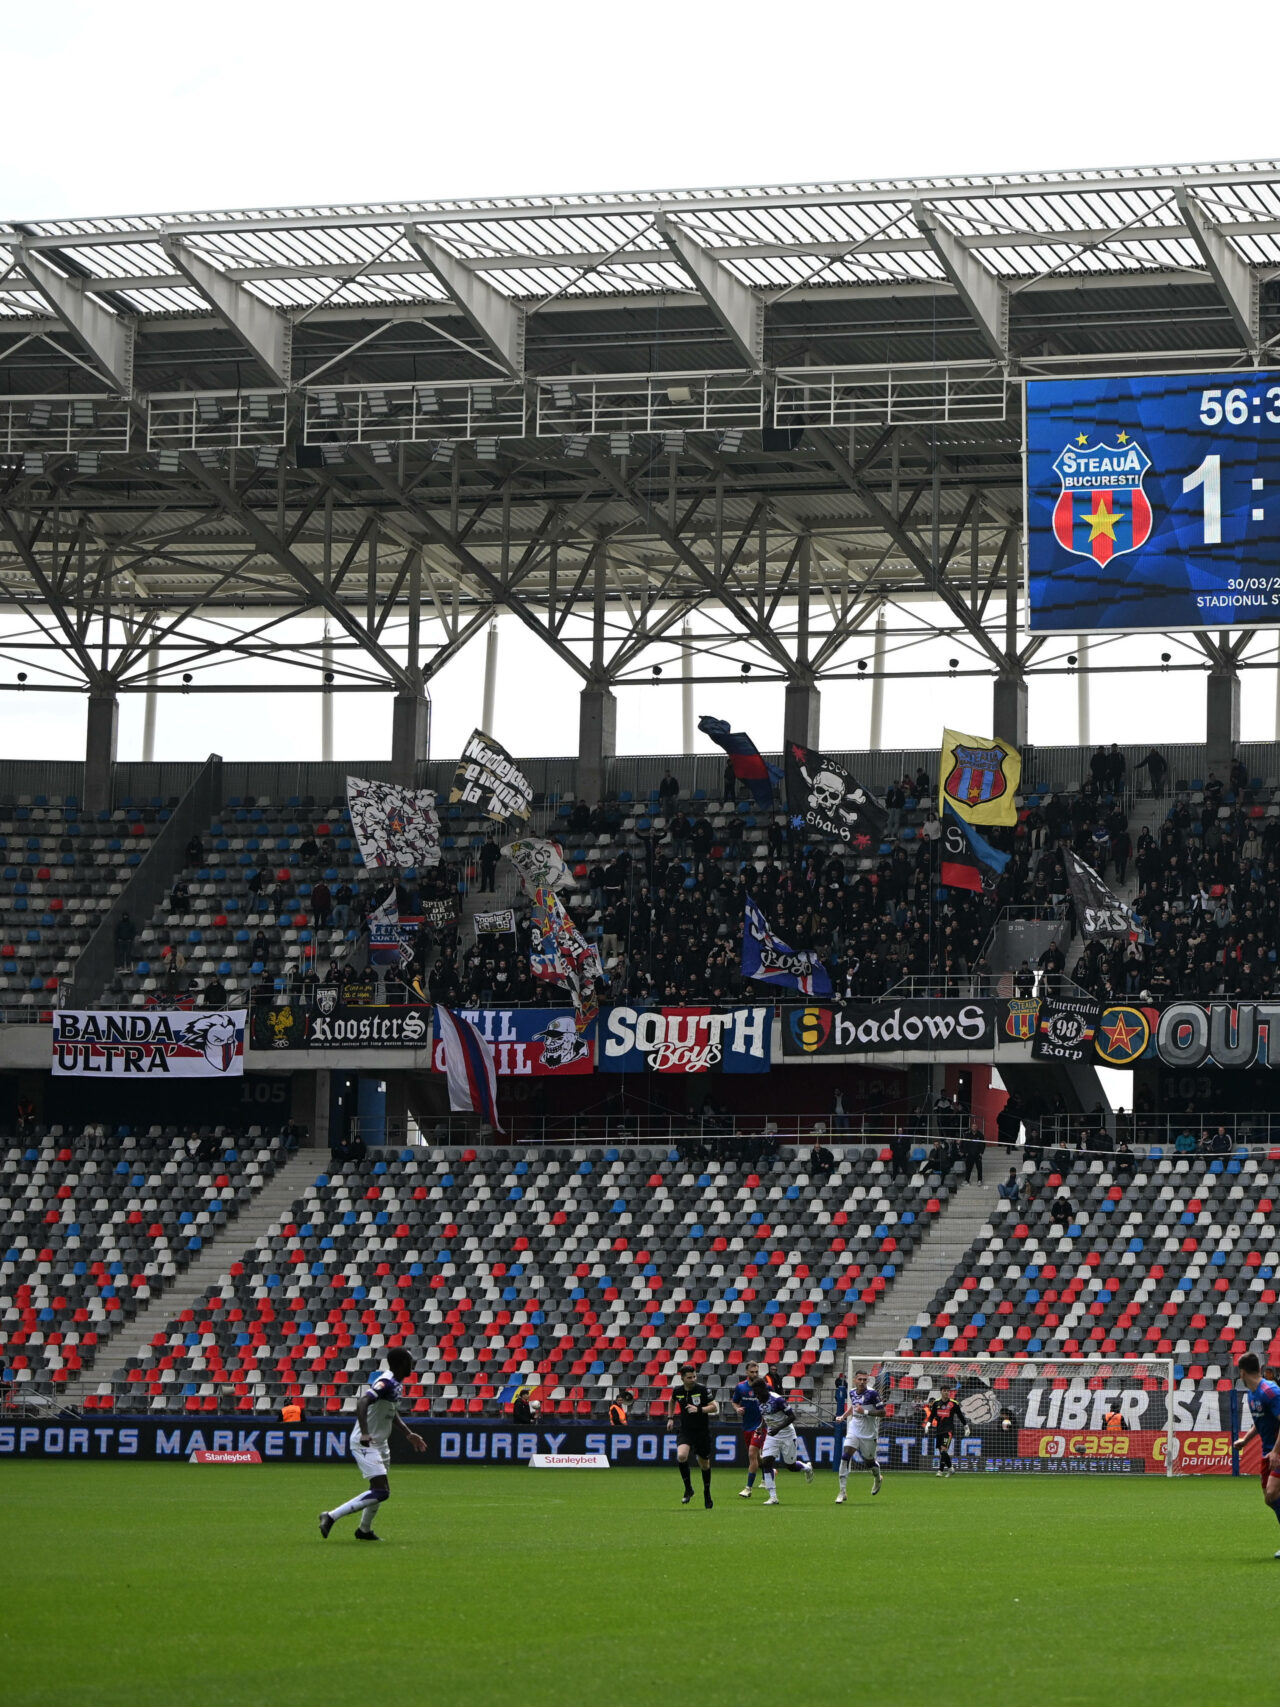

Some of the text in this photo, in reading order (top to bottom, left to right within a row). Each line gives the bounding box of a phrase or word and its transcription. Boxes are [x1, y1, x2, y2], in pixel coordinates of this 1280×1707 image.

[1063, 451, 1141, 473] STEAUA
[1065, 475, 1139, 486] BUCURESTI
[1197, 594, 1268, 606] STADIONUL
[58, 1014, 176, 1042] BANDA
[440, 1011, 516, 1041] TIL
[605, 1006, 767, 1058] SOUTH
[1056, 1020, 1078, 1037] 98
[648, 1042, 722, 1073] Boys
[240, 1082, 286, 1103] 105
[1024, 1389, 1149, 1430] LIBER
[1161, 1390, 1221, 1431] SA
[0, 1427, 348, 1456] SPORTS MARKETIN
[1069, 1436, 1130, 1454] casa
[205, 1452, 252, 1463] Stanleybet
[544, 1455, 597, 1465] Stanleybet
